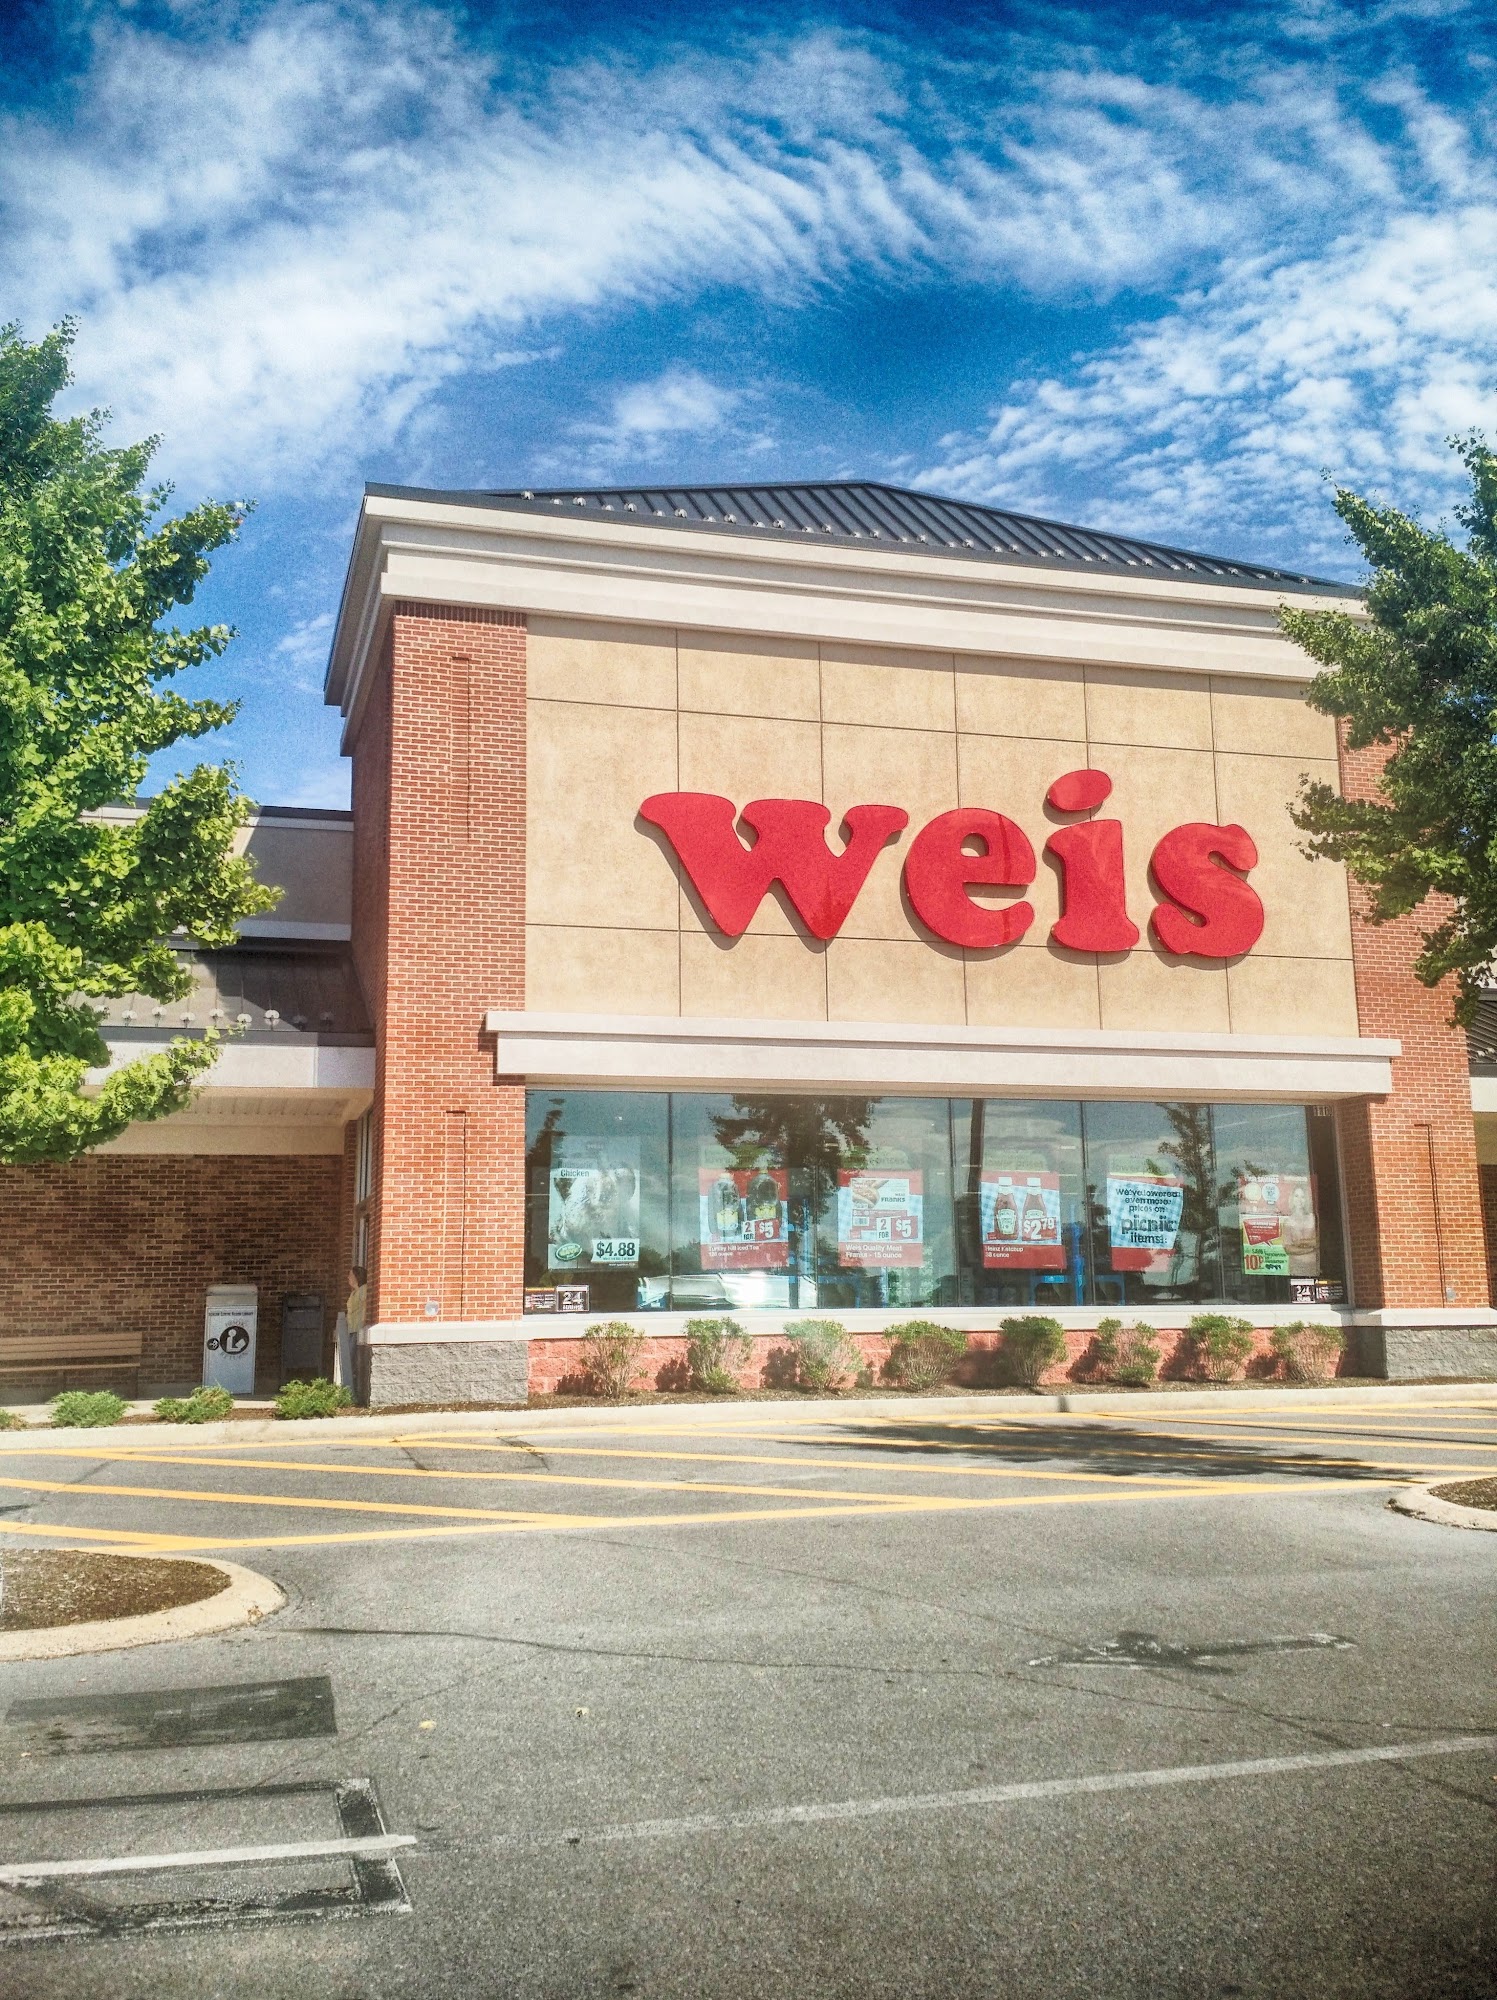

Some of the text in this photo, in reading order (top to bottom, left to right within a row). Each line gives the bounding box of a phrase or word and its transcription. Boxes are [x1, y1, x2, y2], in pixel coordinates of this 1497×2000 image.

[639, 768, 1265, 958] weis
[745, 1221, 774, 1239] 2 $5
[880, 1218, 912, 1238] 2 $5
[1121, 1214, 1178, 1235] picnic
[596, 1241, 636, 1259] $4.88
[863, 1244, 885, 1252] Quality
[562, 1291, 583, 1305] 24
